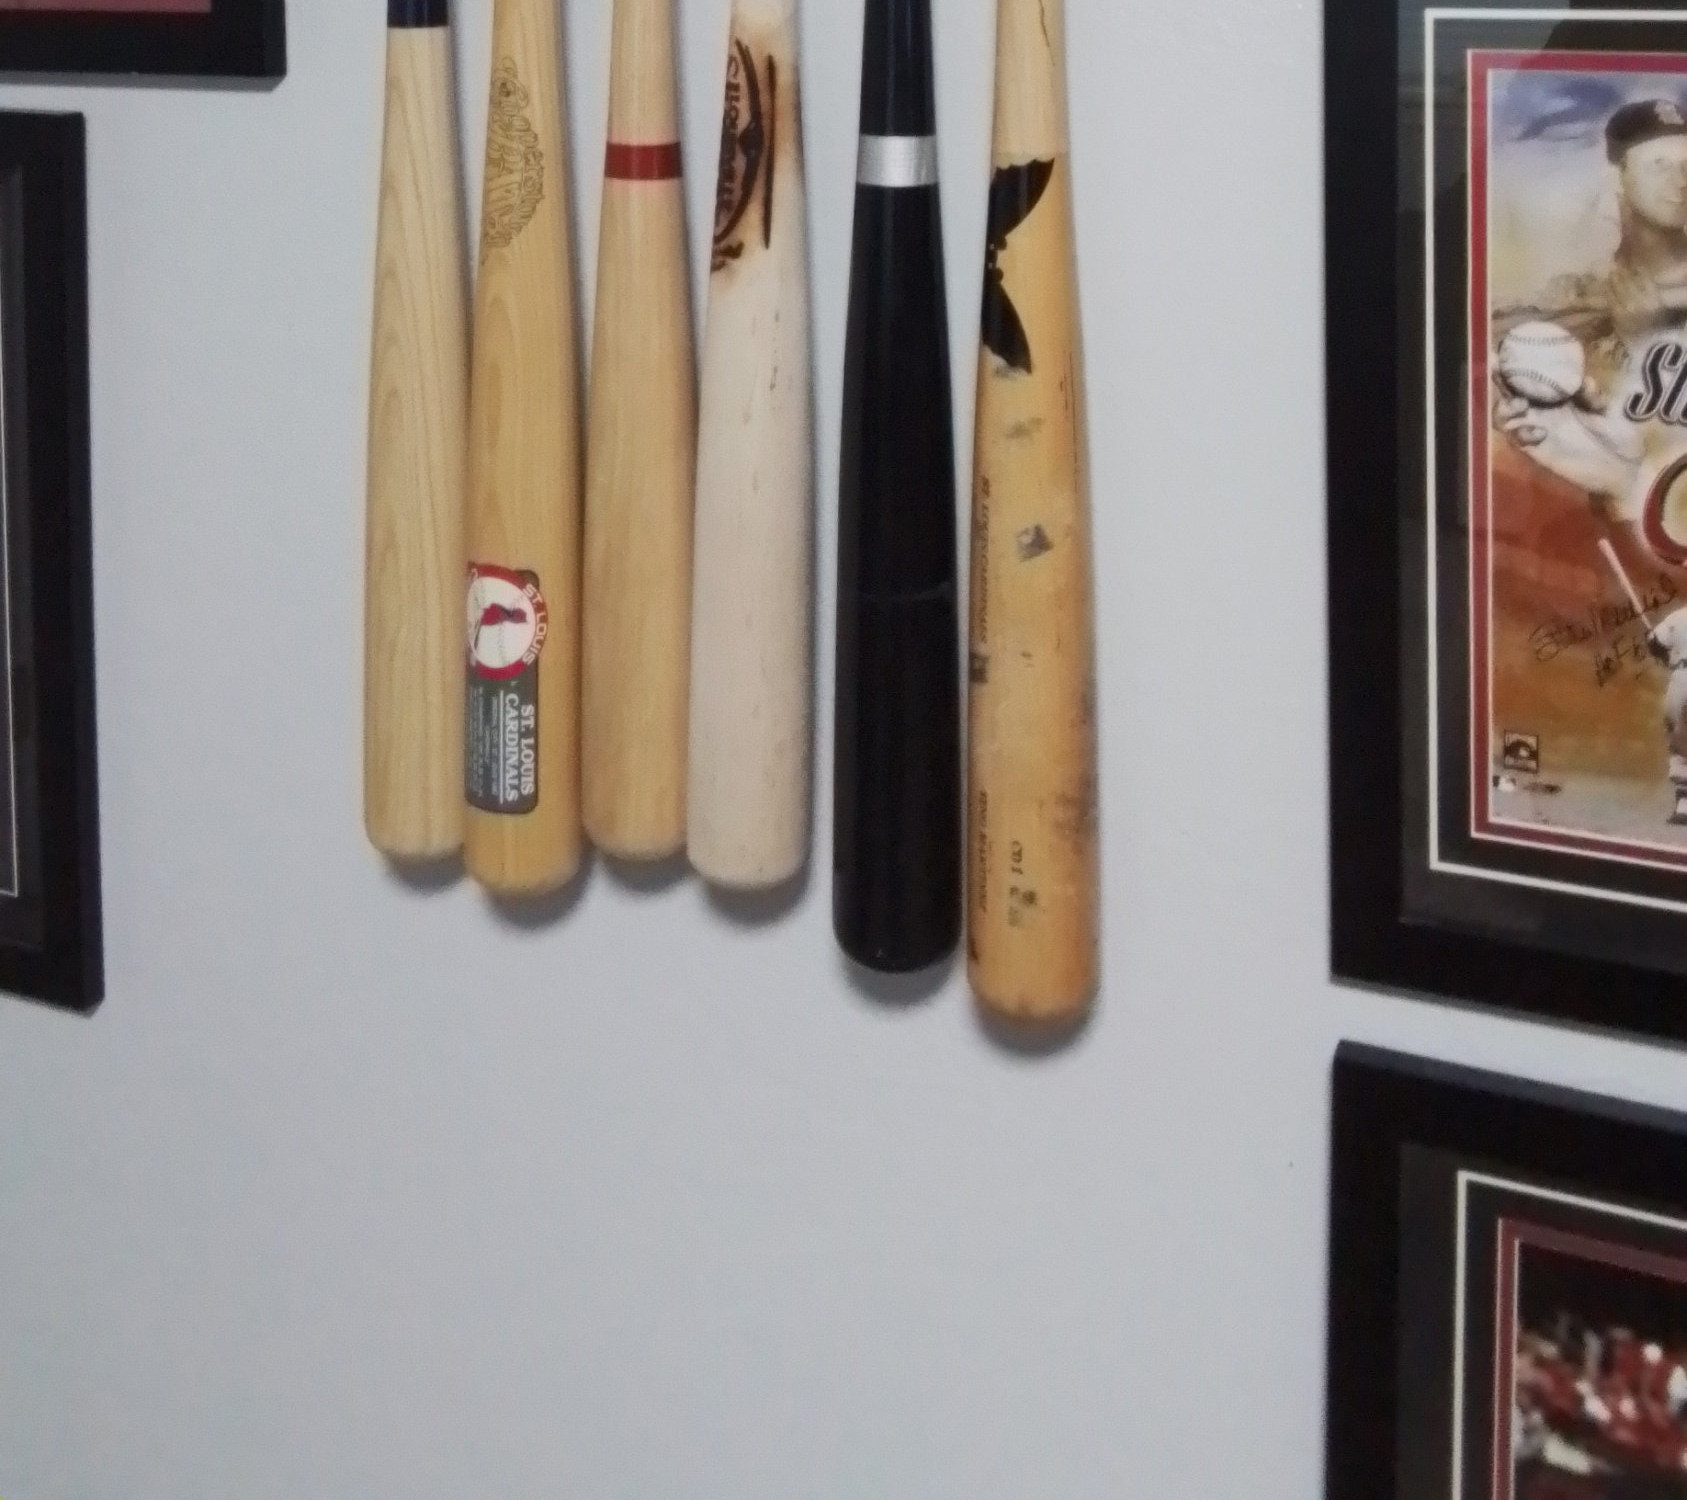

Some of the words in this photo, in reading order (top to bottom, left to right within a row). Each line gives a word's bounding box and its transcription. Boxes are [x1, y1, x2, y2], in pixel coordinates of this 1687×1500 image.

[522, 611, 549, 666] LOUIS
[521, 704, 535, 732] ST.
[505, 692, 520, 802] CARDINALS
[521, 737, 535, 796] LOUIS
